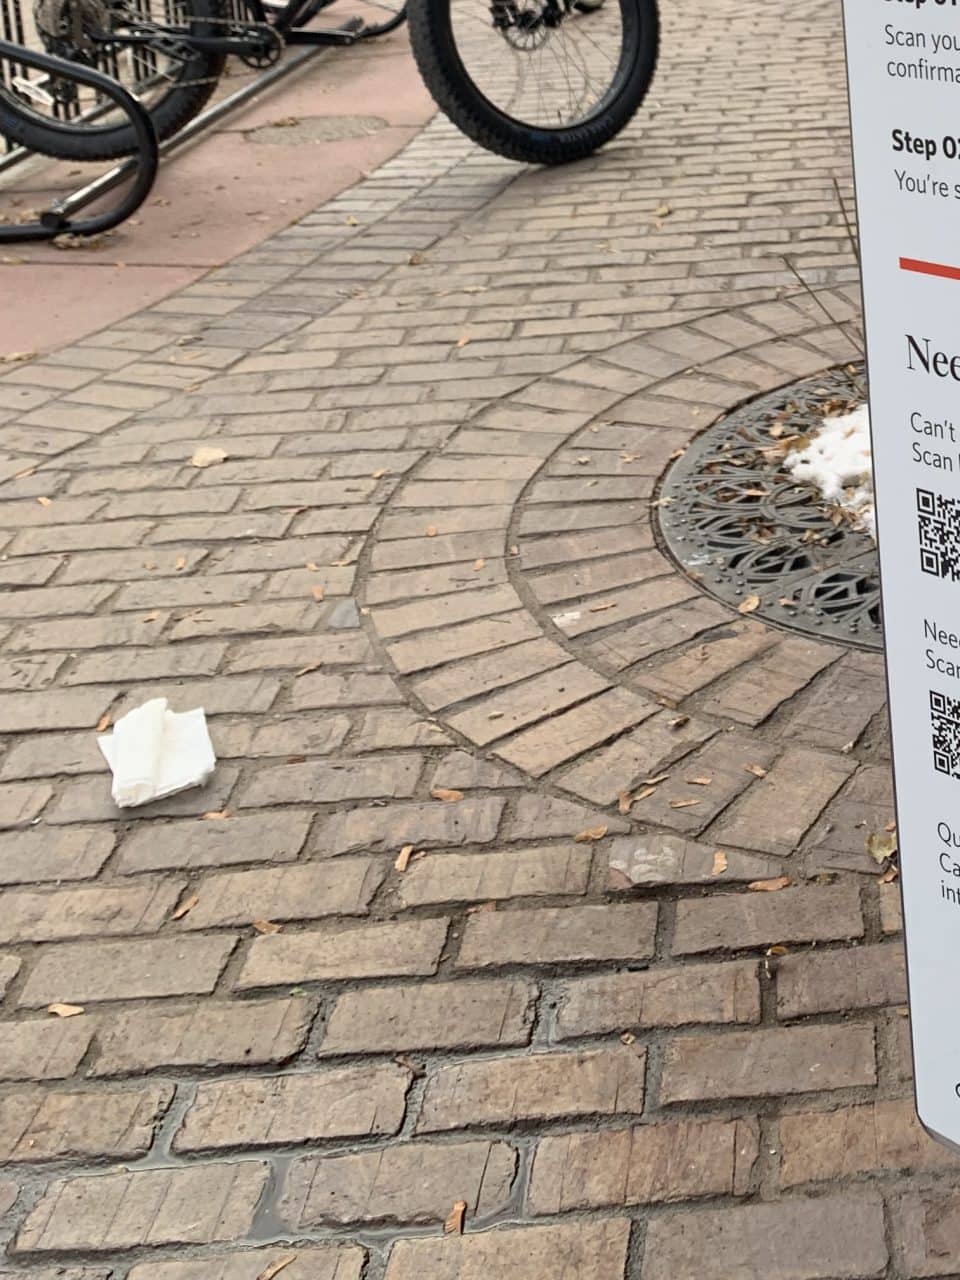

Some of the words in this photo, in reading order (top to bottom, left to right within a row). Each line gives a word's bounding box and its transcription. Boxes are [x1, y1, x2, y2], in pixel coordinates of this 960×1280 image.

[885, 24, 926, 50] Scan
[891, 129, 937, 161] Step
[894, 169, 949, 198] You're
[910, 412, 956, 443] Can't
[912, 441, 953, 472] Scan
